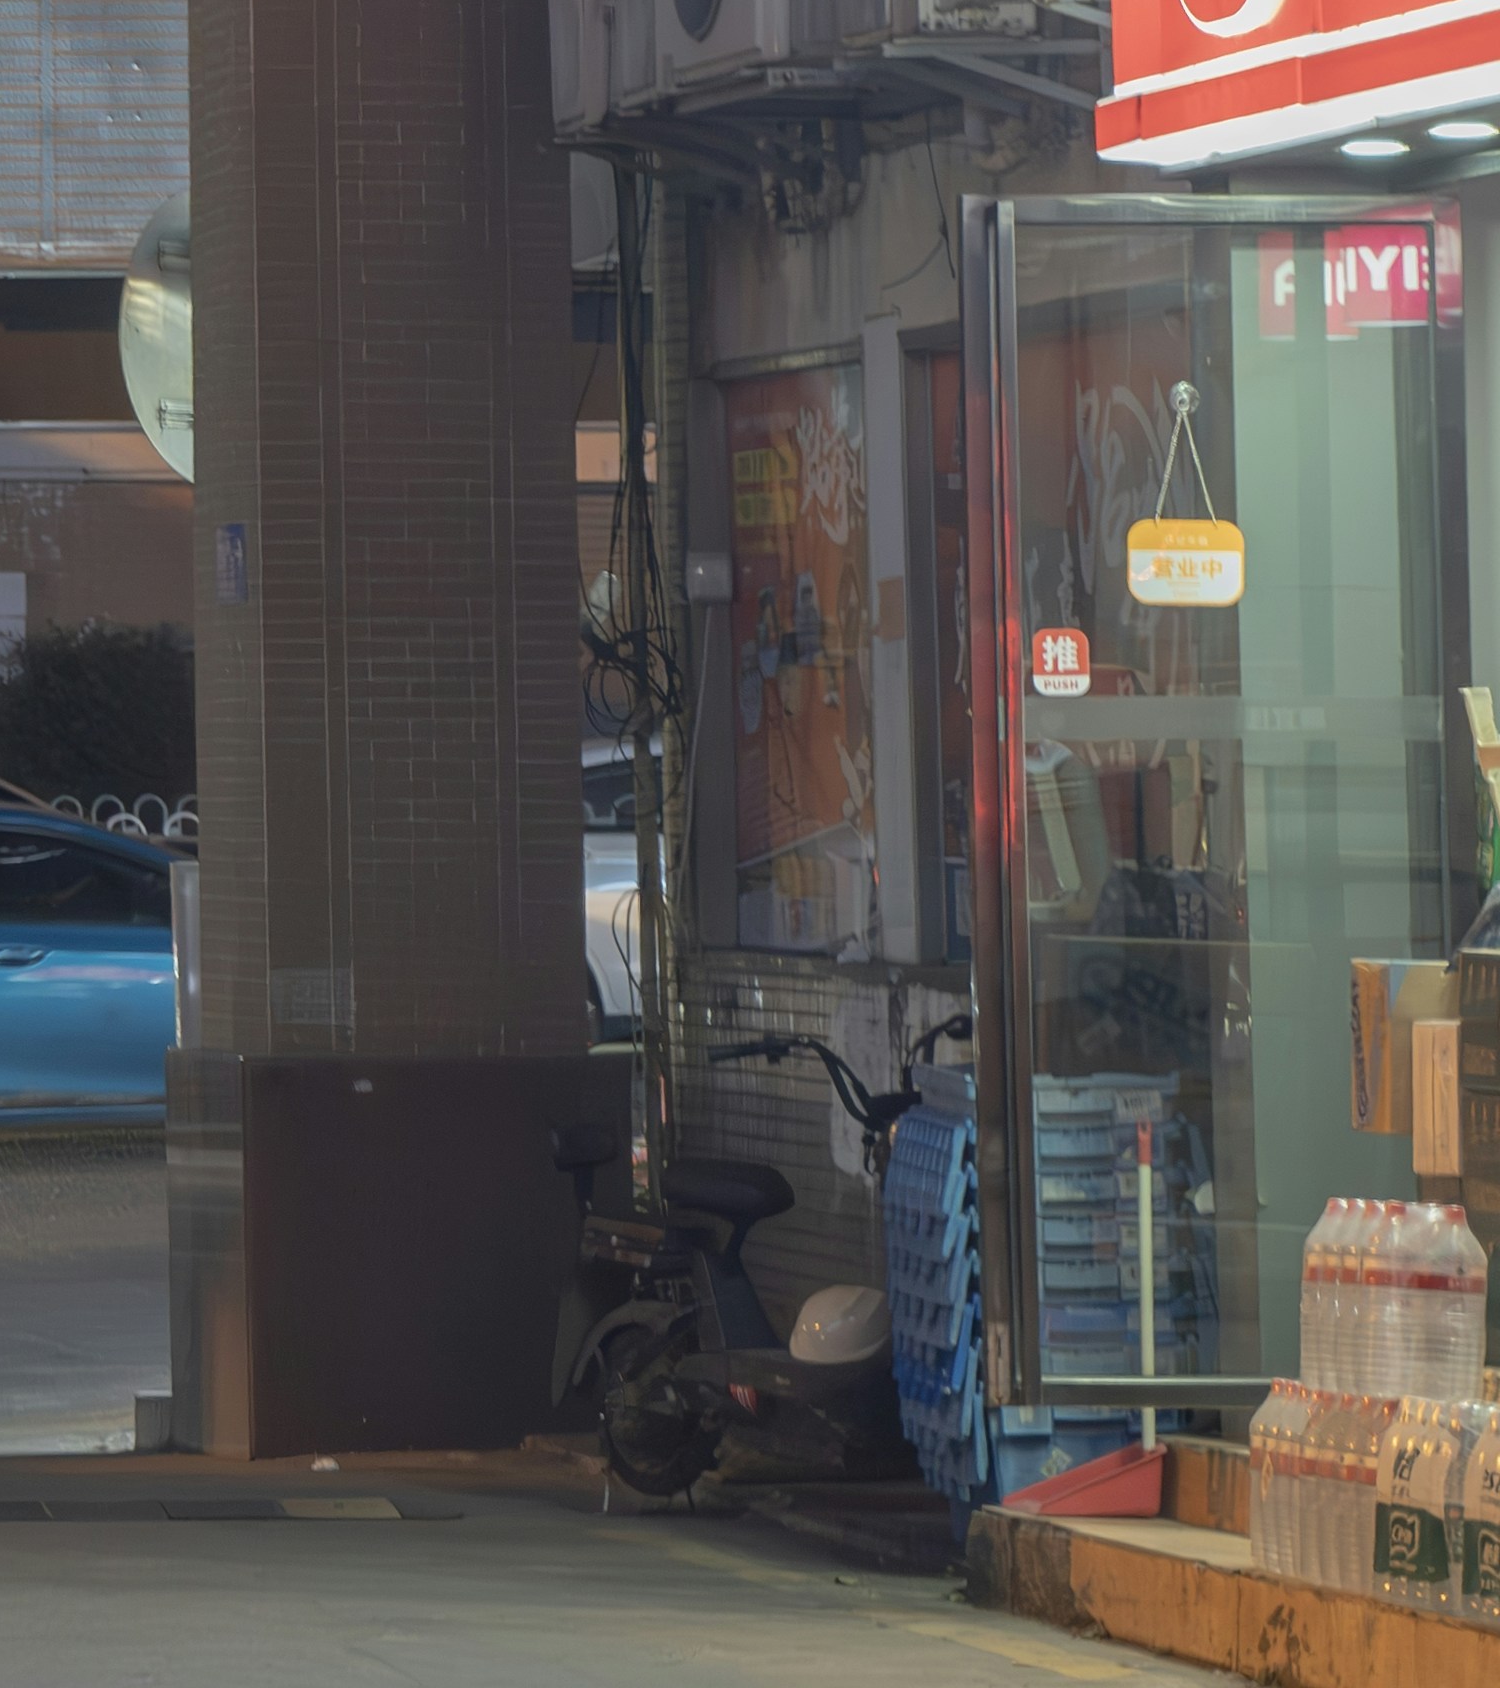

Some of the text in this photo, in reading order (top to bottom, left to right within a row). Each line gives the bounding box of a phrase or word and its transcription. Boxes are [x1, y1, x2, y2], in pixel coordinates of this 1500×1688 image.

[1153, 555, 1223, 580] 营业中
[1042, 635, 1080, 673] 推
[1043, 679, 1079, 691] PUSH
